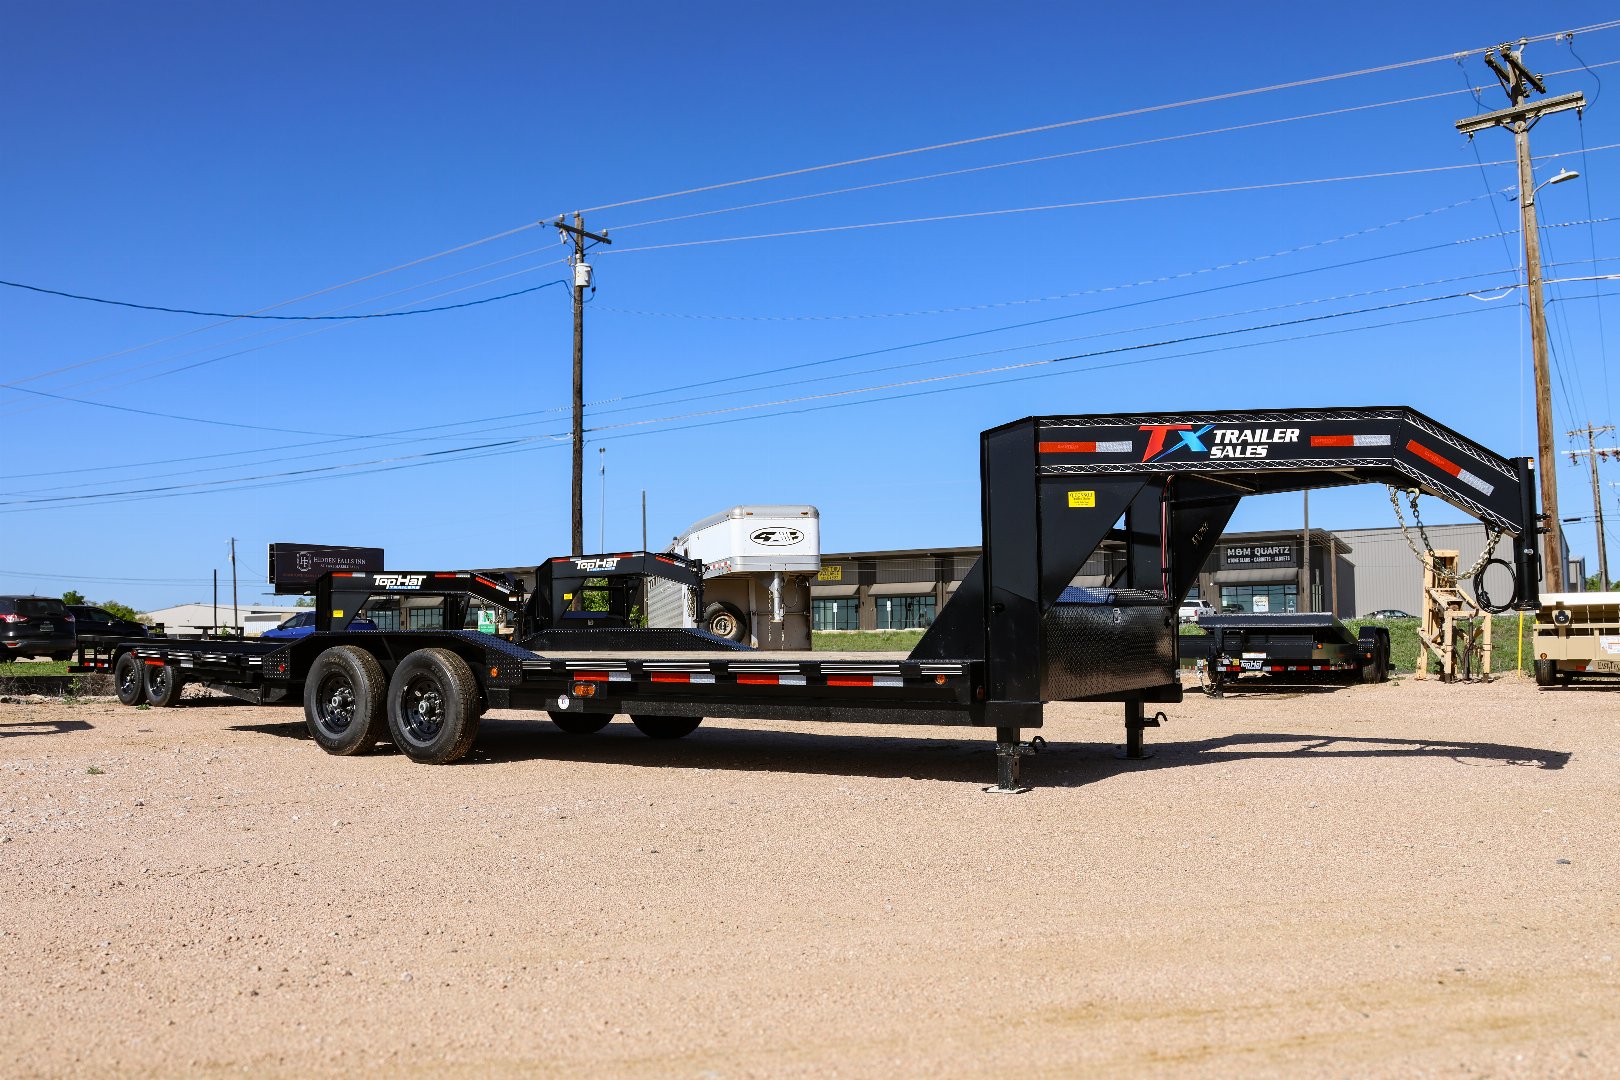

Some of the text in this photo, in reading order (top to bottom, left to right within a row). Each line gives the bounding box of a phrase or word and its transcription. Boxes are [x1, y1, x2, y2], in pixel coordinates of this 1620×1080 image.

[1138, 424, 1216, 463] TX
[1213, 428, 1300, 445] TRAILER
[1210, 445, 1269, 459] SALES
[1227, 546, 1290, 556] M&M QUARTZ
[313, 556, 336, 564] HIDDEN
